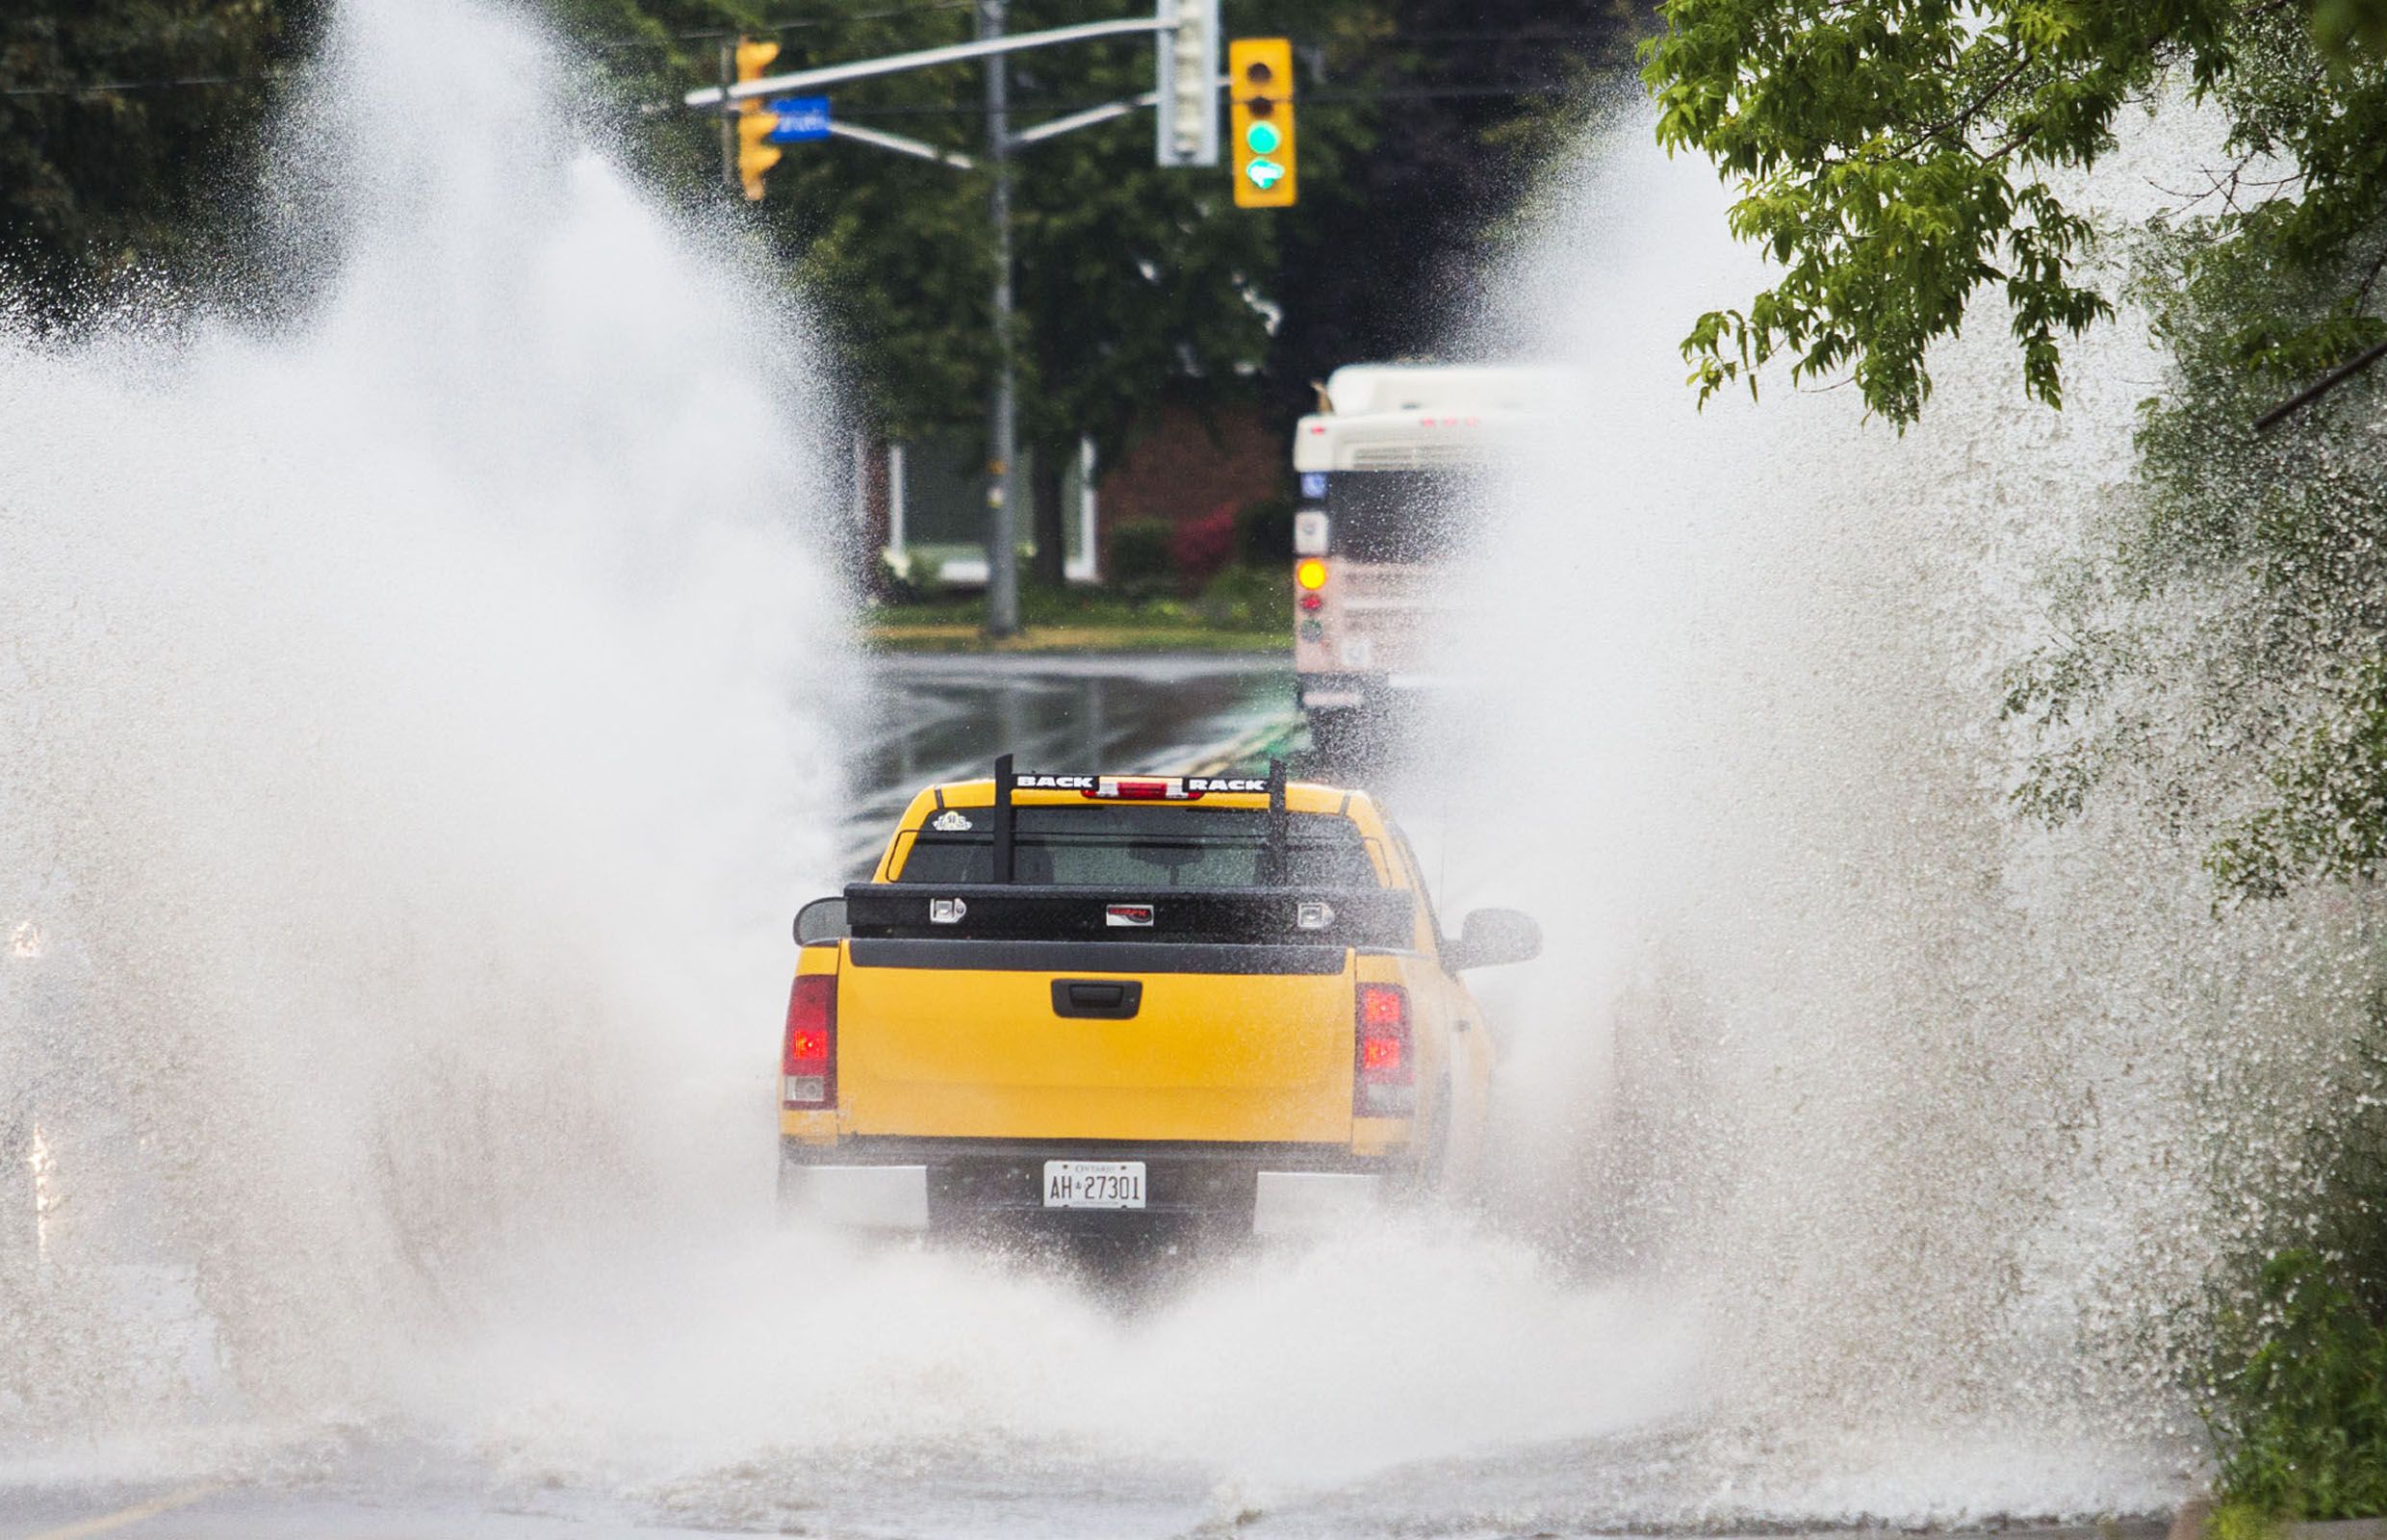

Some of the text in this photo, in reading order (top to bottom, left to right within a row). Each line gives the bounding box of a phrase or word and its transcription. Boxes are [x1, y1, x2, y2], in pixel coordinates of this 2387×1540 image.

[1017, 776, 1265, 790] BACK RACK
[1050, 1175, 1140, 1200] AH 27301
